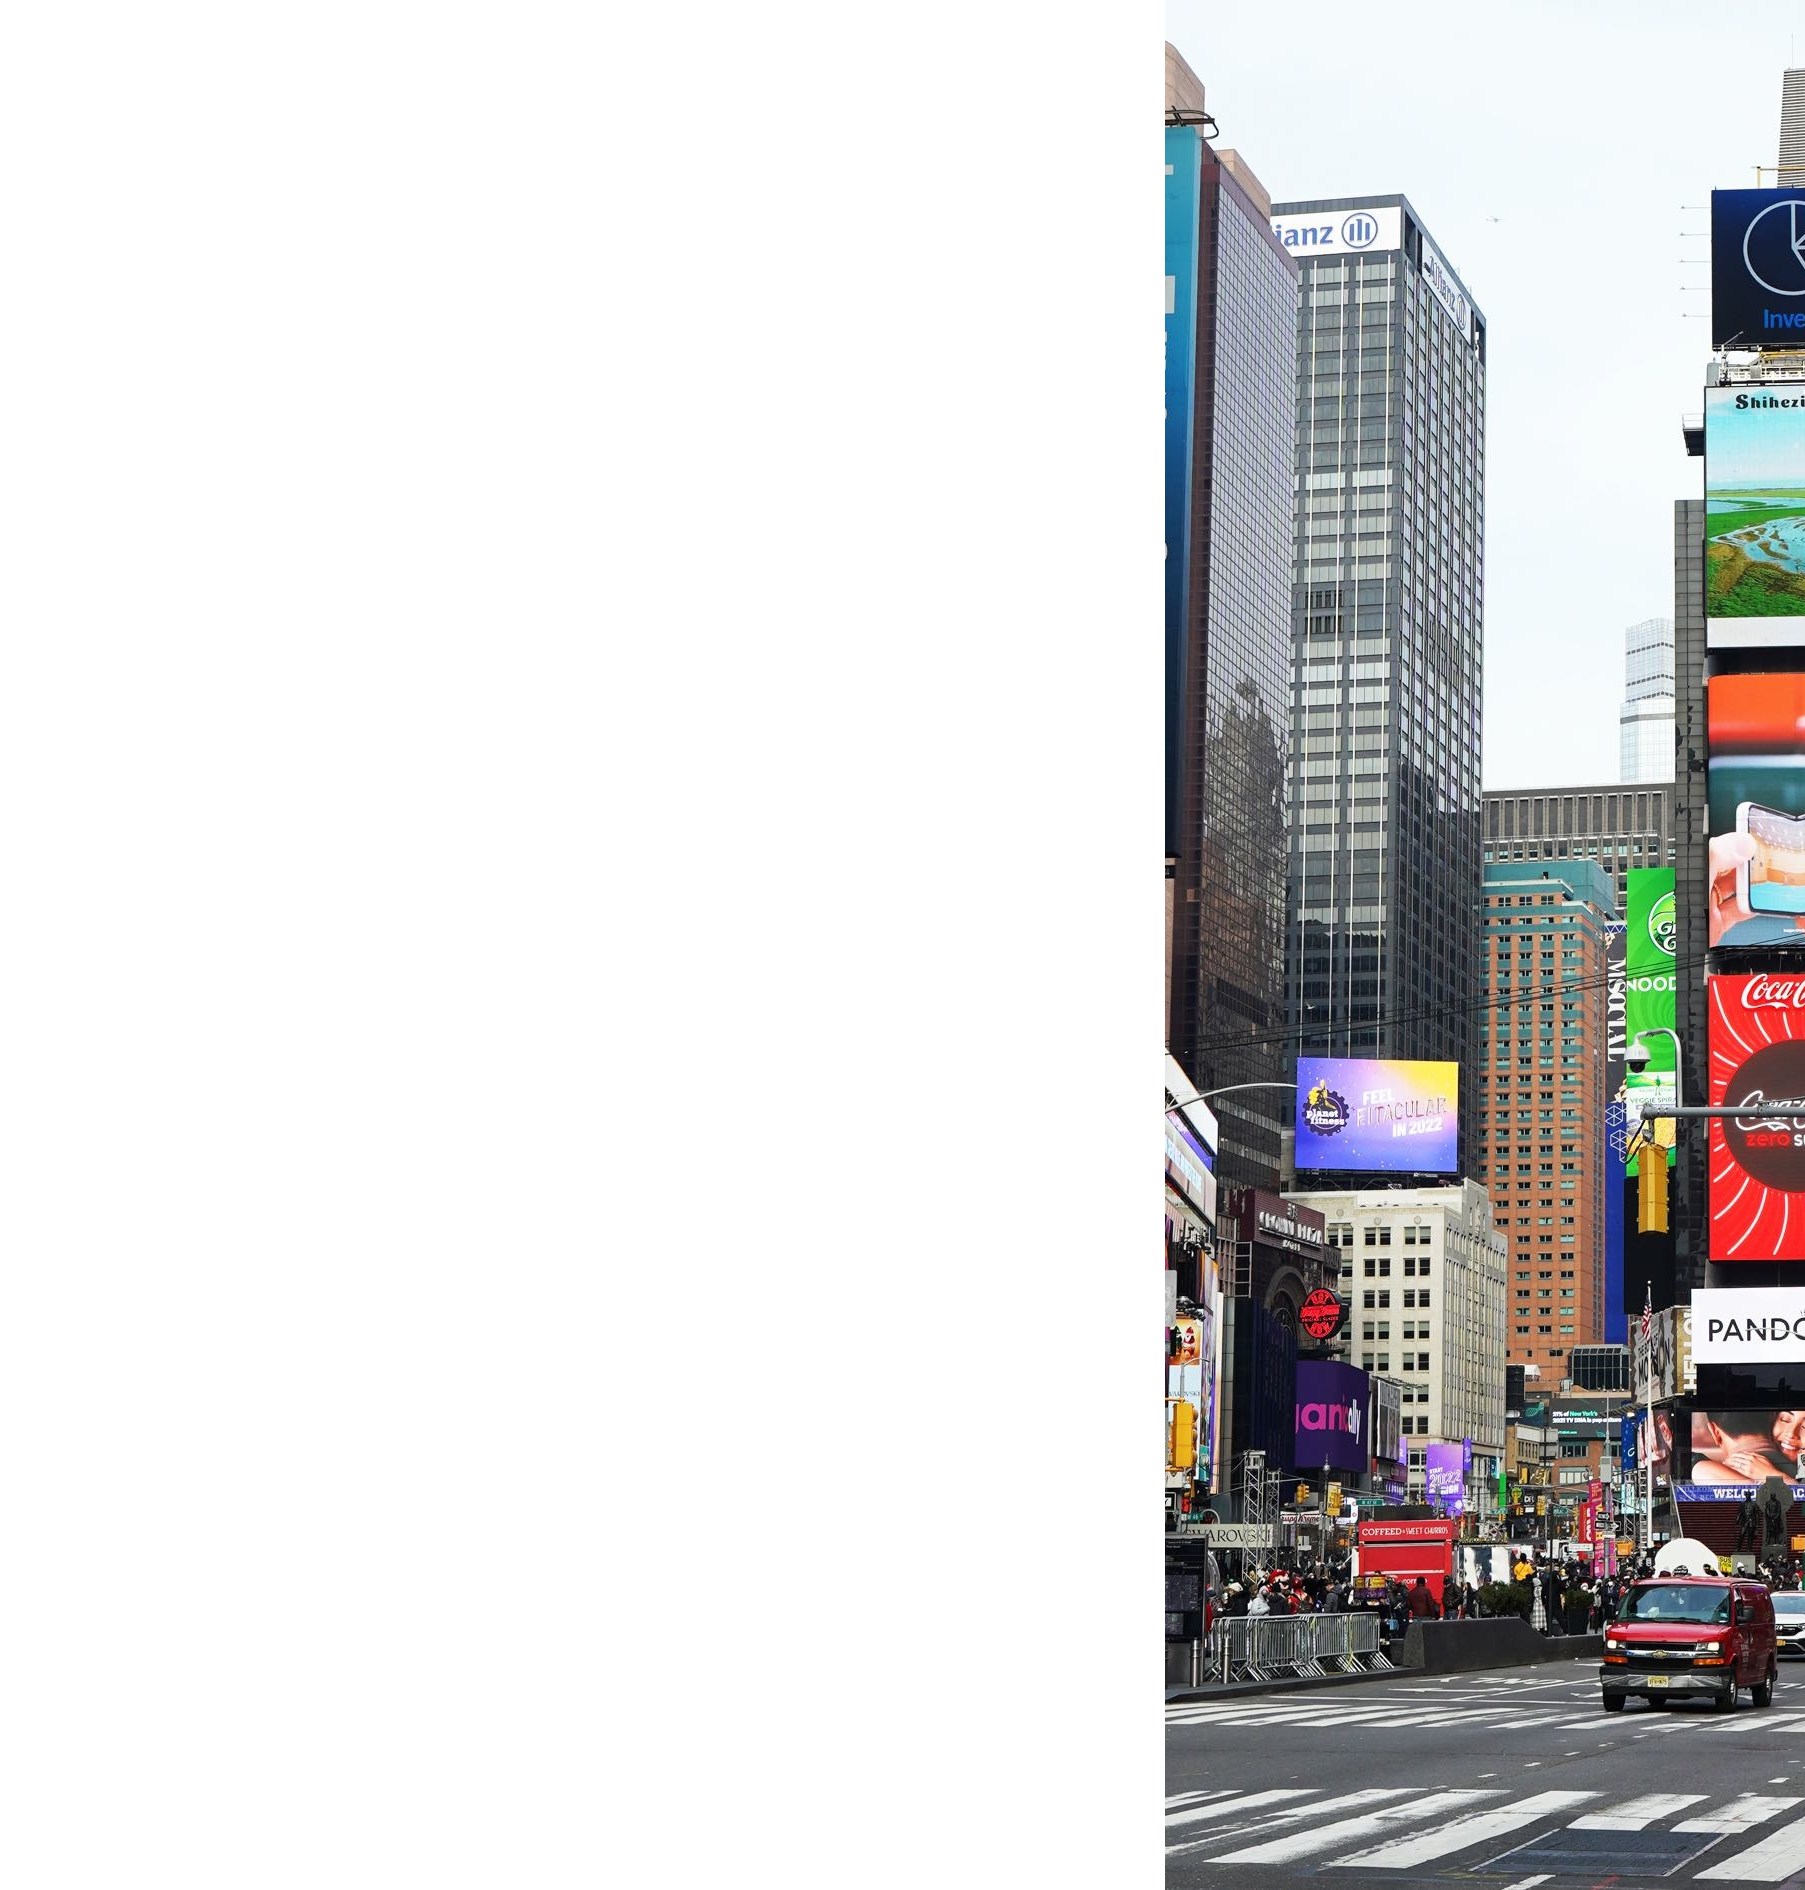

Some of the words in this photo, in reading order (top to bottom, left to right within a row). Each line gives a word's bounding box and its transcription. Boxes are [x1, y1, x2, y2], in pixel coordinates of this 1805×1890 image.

[1735, 394, 1805, 409] Shihezi
[1363, 1088, 1395, 1106] FEEL
[1306, 1109, 1339, 1119] planet
[1310, 1116, 1345, 1126] fitness
[1392, 1123, 1406, 1138] IN
[1409, 1116, 1443, 1135] 2022
[1747, 1134, 1790, 1147] zero
[1362, 1528, 1402, 1536] COFFEED
[1424, 1526, 1448, 1534] CHURROS
